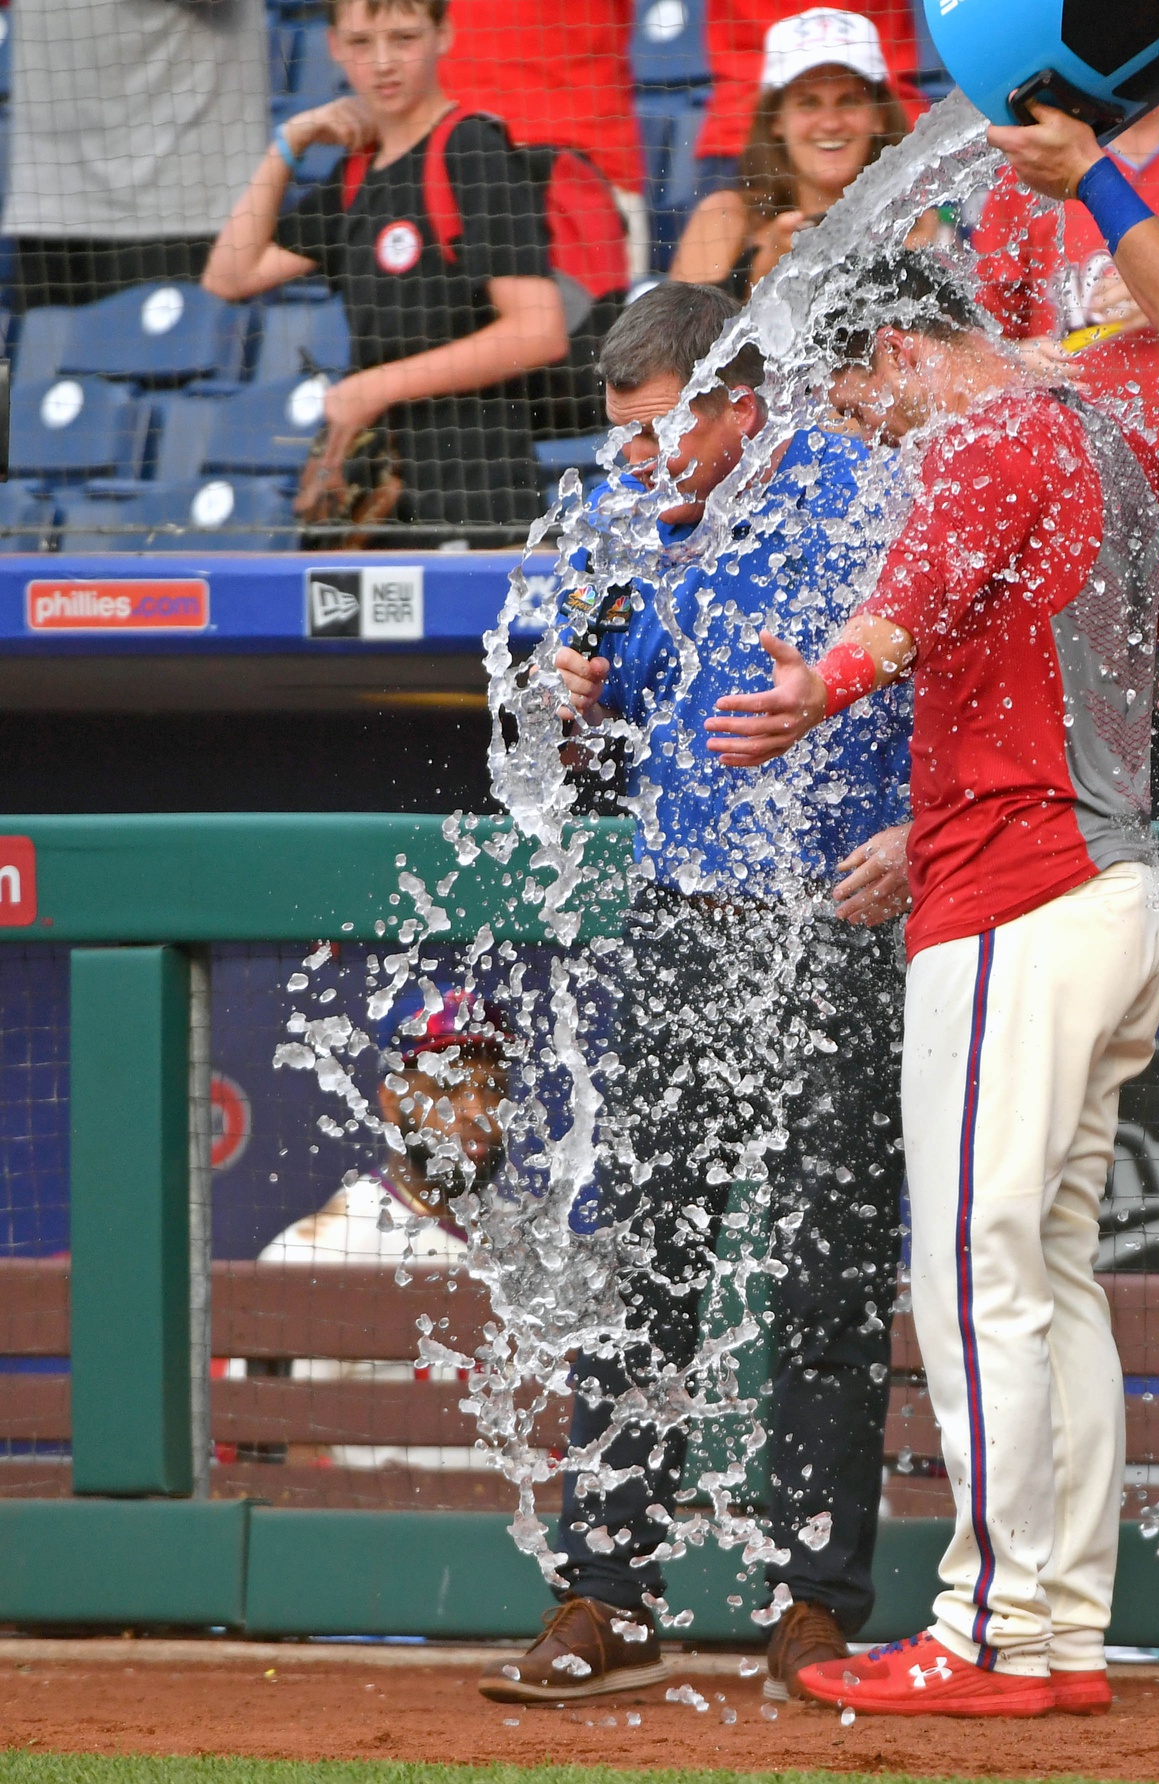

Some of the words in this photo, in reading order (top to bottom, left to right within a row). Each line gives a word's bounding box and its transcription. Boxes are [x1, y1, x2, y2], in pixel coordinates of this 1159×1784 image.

[372, 582, 414, 601] NEW
[35, 590, 199, 624] phillies.com
[373, 603, 414, 623] ERA
